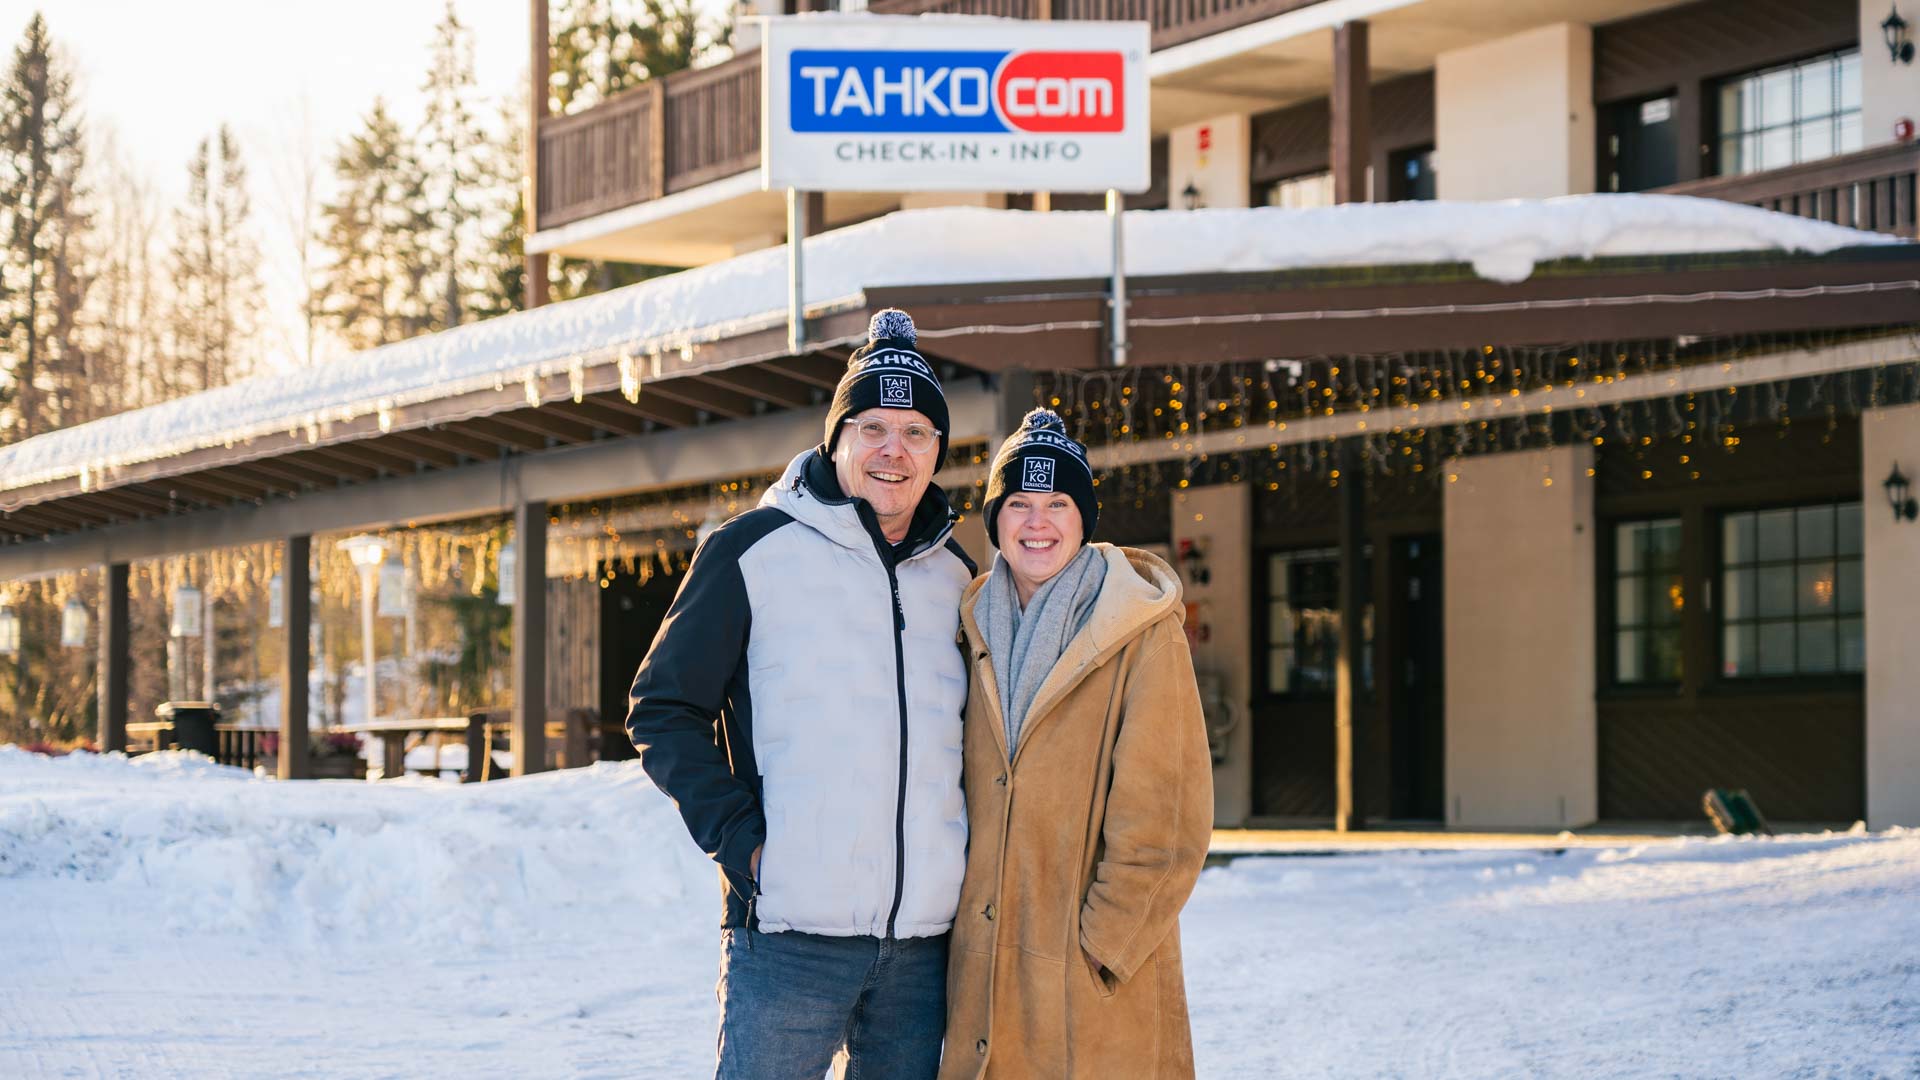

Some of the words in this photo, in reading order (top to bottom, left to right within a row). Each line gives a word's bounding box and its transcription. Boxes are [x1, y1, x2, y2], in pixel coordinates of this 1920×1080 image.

[801, 67, 989, 116] TAHKO
[1005, 78, 1113, 117] com
[836, 141, 979, 161] CHECK-IN
[1010, 141, 1080, 161] INFO
[884, 378, 907, 387] TAH
[888, 389, 904, 398] KO
[1028, 460, 1050, 470] TAH
[1030, 472, 1046, 483] KO
